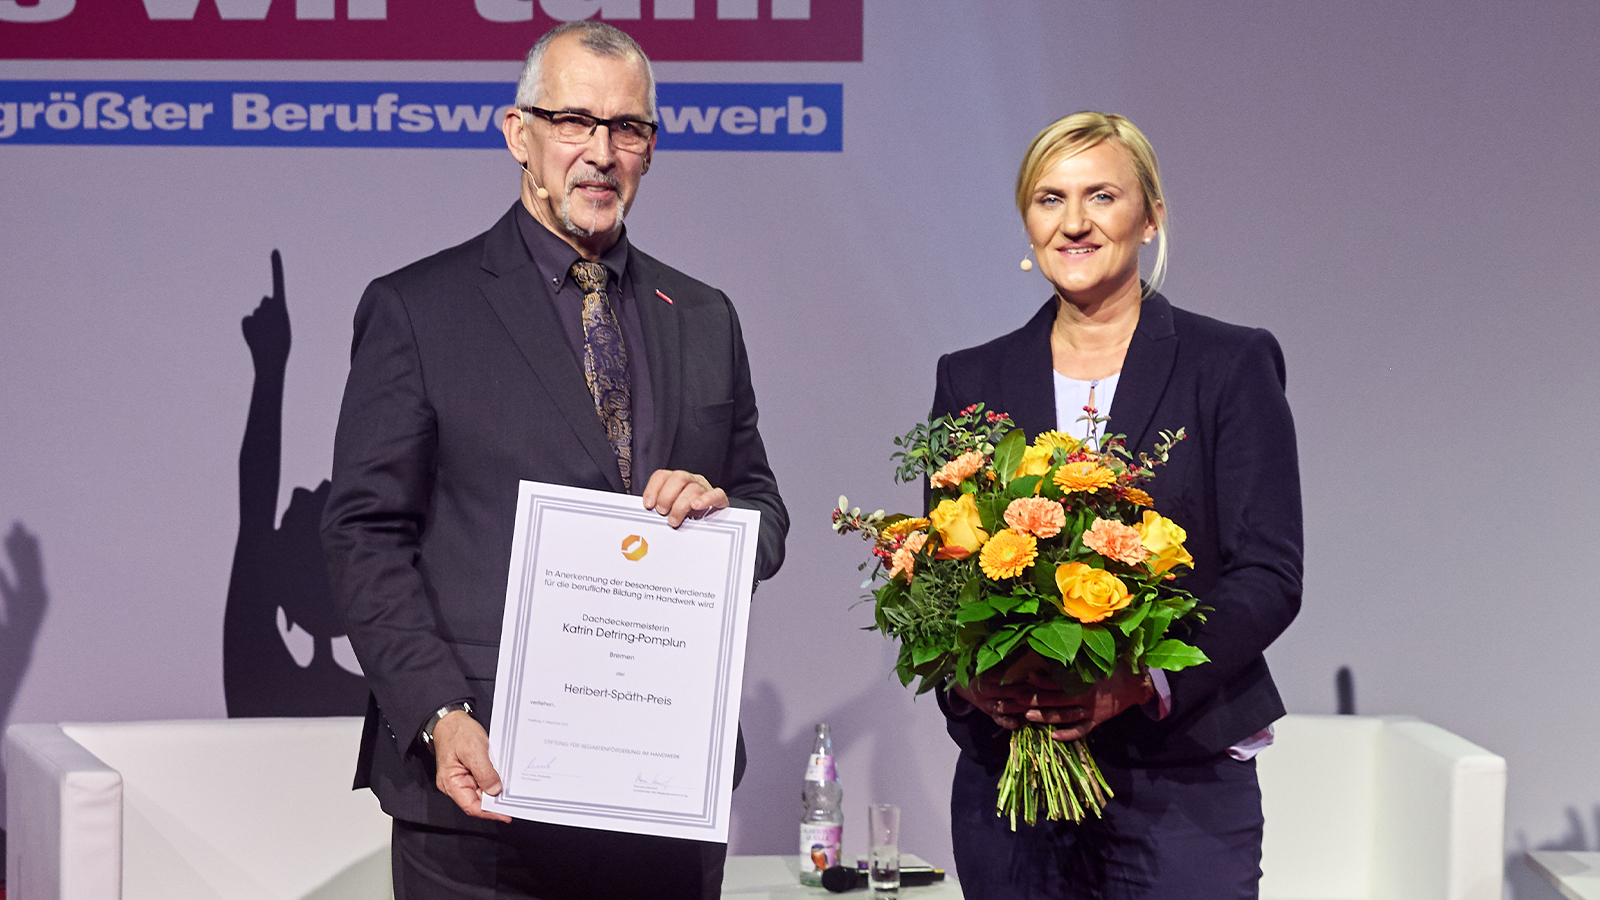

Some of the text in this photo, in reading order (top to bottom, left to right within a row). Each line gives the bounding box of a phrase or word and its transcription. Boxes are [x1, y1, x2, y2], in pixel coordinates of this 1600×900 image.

[232, 93, 828, 136] Berufswwerb
[544, 578, 715, 609] für die berufliche Bildung im Handwerk wird
[545, 569, 716, 600] In Anerkennung der besonderen Verdienste
[582, 613, 670, 633] Dachdeckermeisterin
[562, 623, 687, 649] Katrin Detring-Pomplun
[609, 651, 635, 661] Bremen
[564, 683, 672, 706] Heribert-Späth-Preis
[650, 751, 681, 760] HANDWERK
